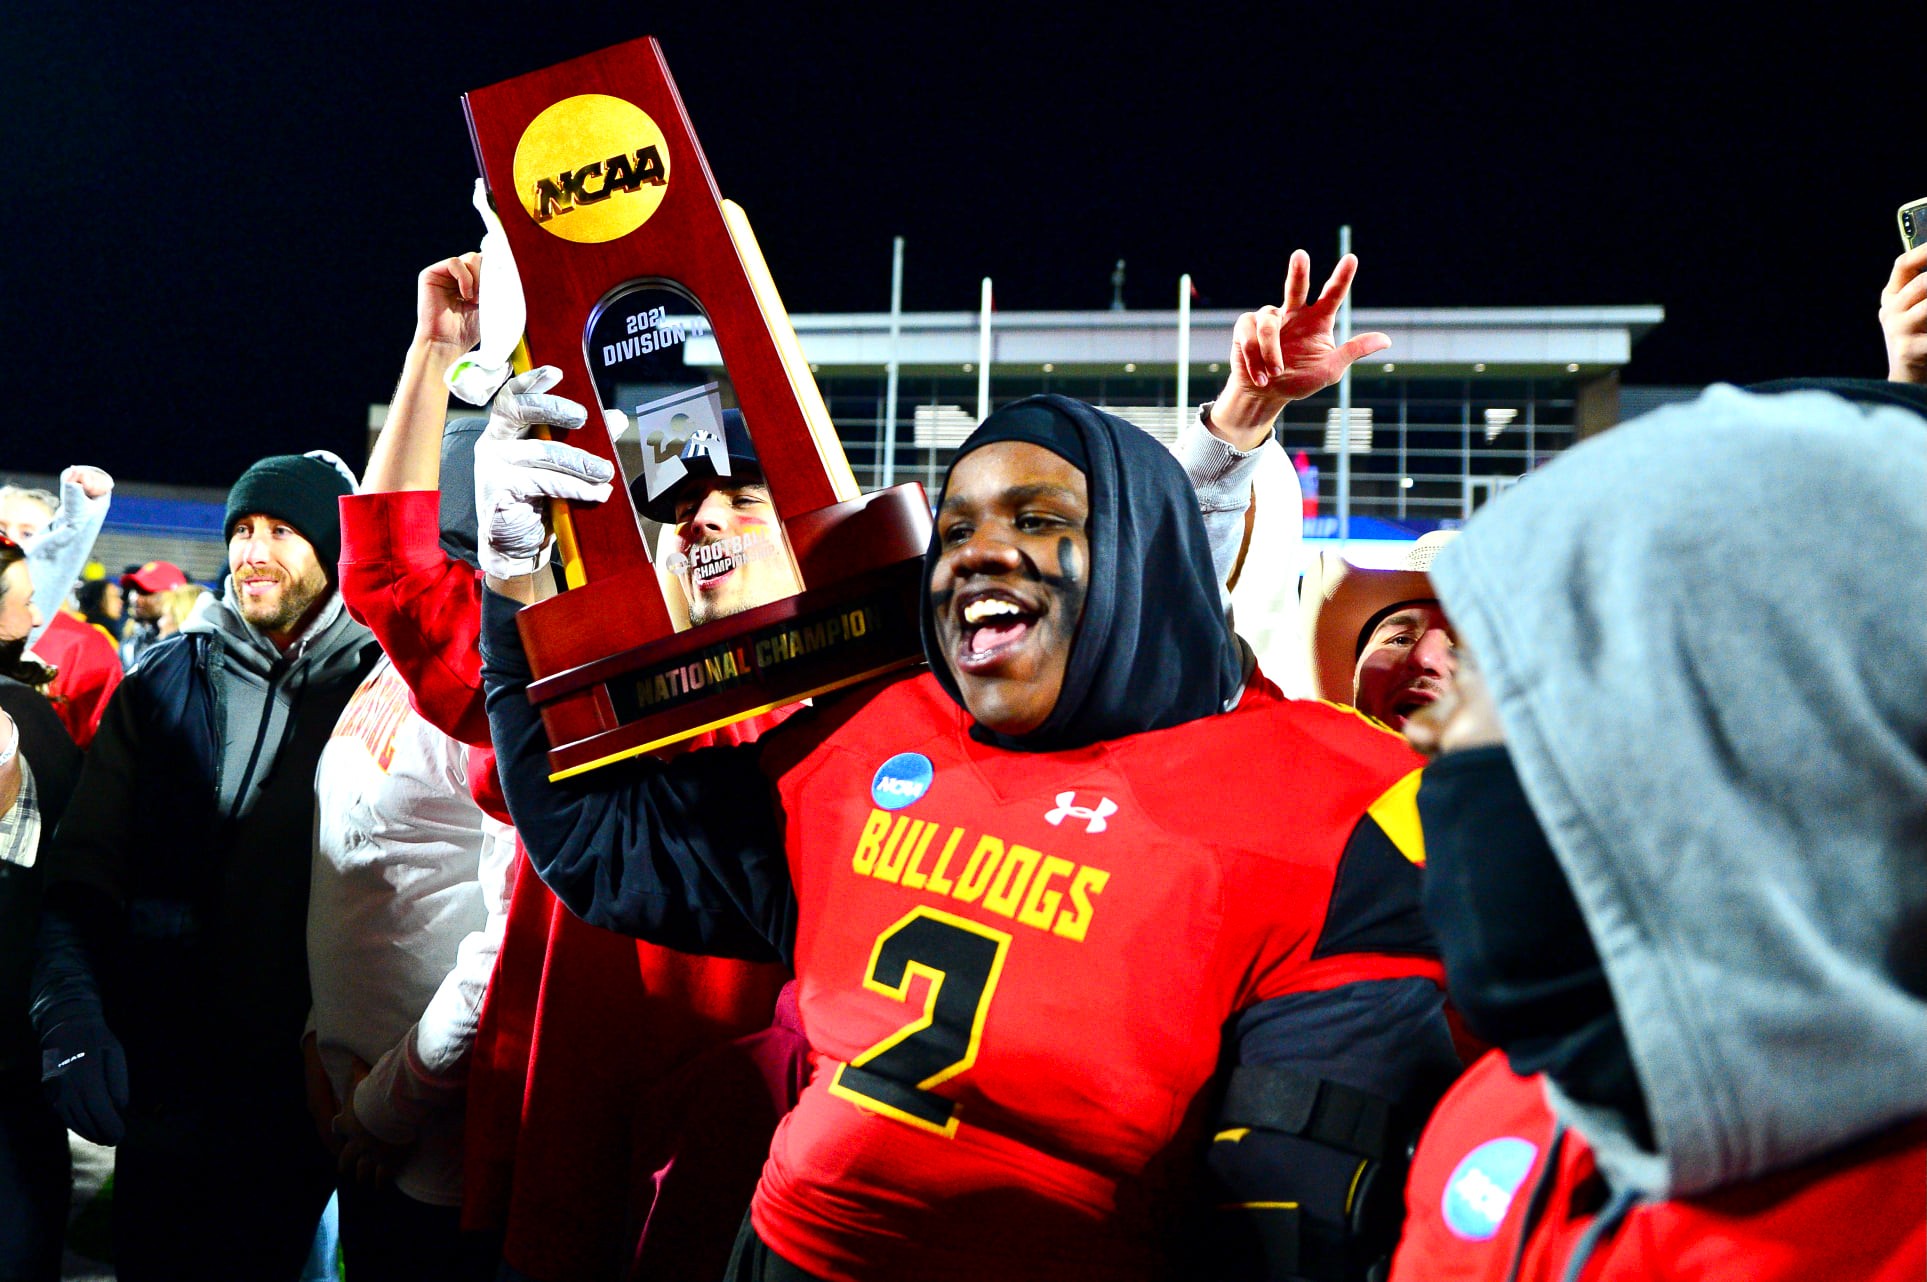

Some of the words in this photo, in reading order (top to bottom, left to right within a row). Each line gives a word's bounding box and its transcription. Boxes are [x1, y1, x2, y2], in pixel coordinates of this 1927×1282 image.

[534, 144, 667, 224] NCAA
[603, 323, 686, 367] DIVISION
[626, 305, 666, 335] 2021
[690, 529, 770, 567] FOOTBALL
[635, 646, 751, 708] NATIONAL
[852, 808, 1110, 943] BULLDOGS
[828, 905, 1013, 1140] 2
